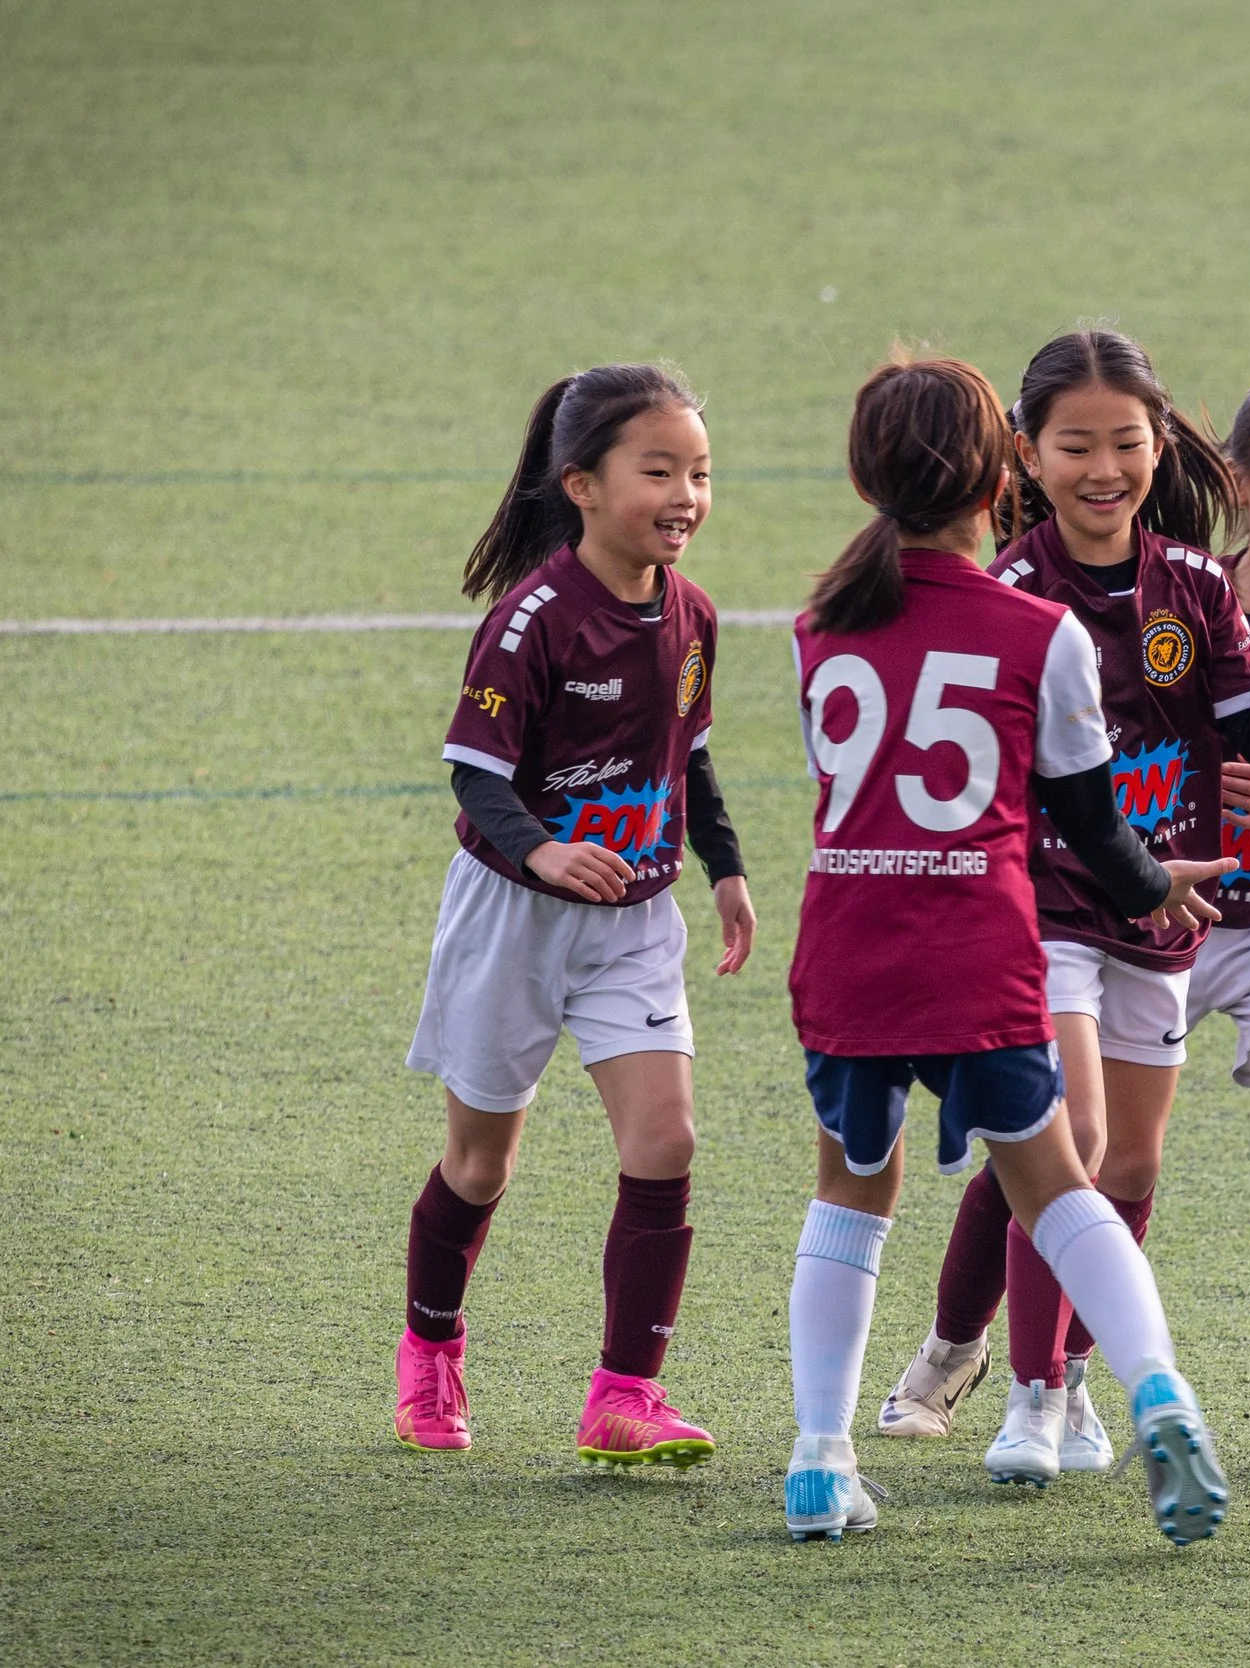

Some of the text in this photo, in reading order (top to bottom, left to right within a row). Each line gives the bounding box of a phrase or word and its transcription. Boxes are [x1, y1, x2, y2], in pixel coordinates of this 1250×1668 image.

[1163, 623, 1188, 644] FOOTBALL
[1181, 644, 1189, 663] CLUB
[564, 678, 623, 699] capelli
[1158, 669, 1178, 682] 2021
[806, 650, 1000, 833] 95
[1112, 756, 1183, 817] OW!
